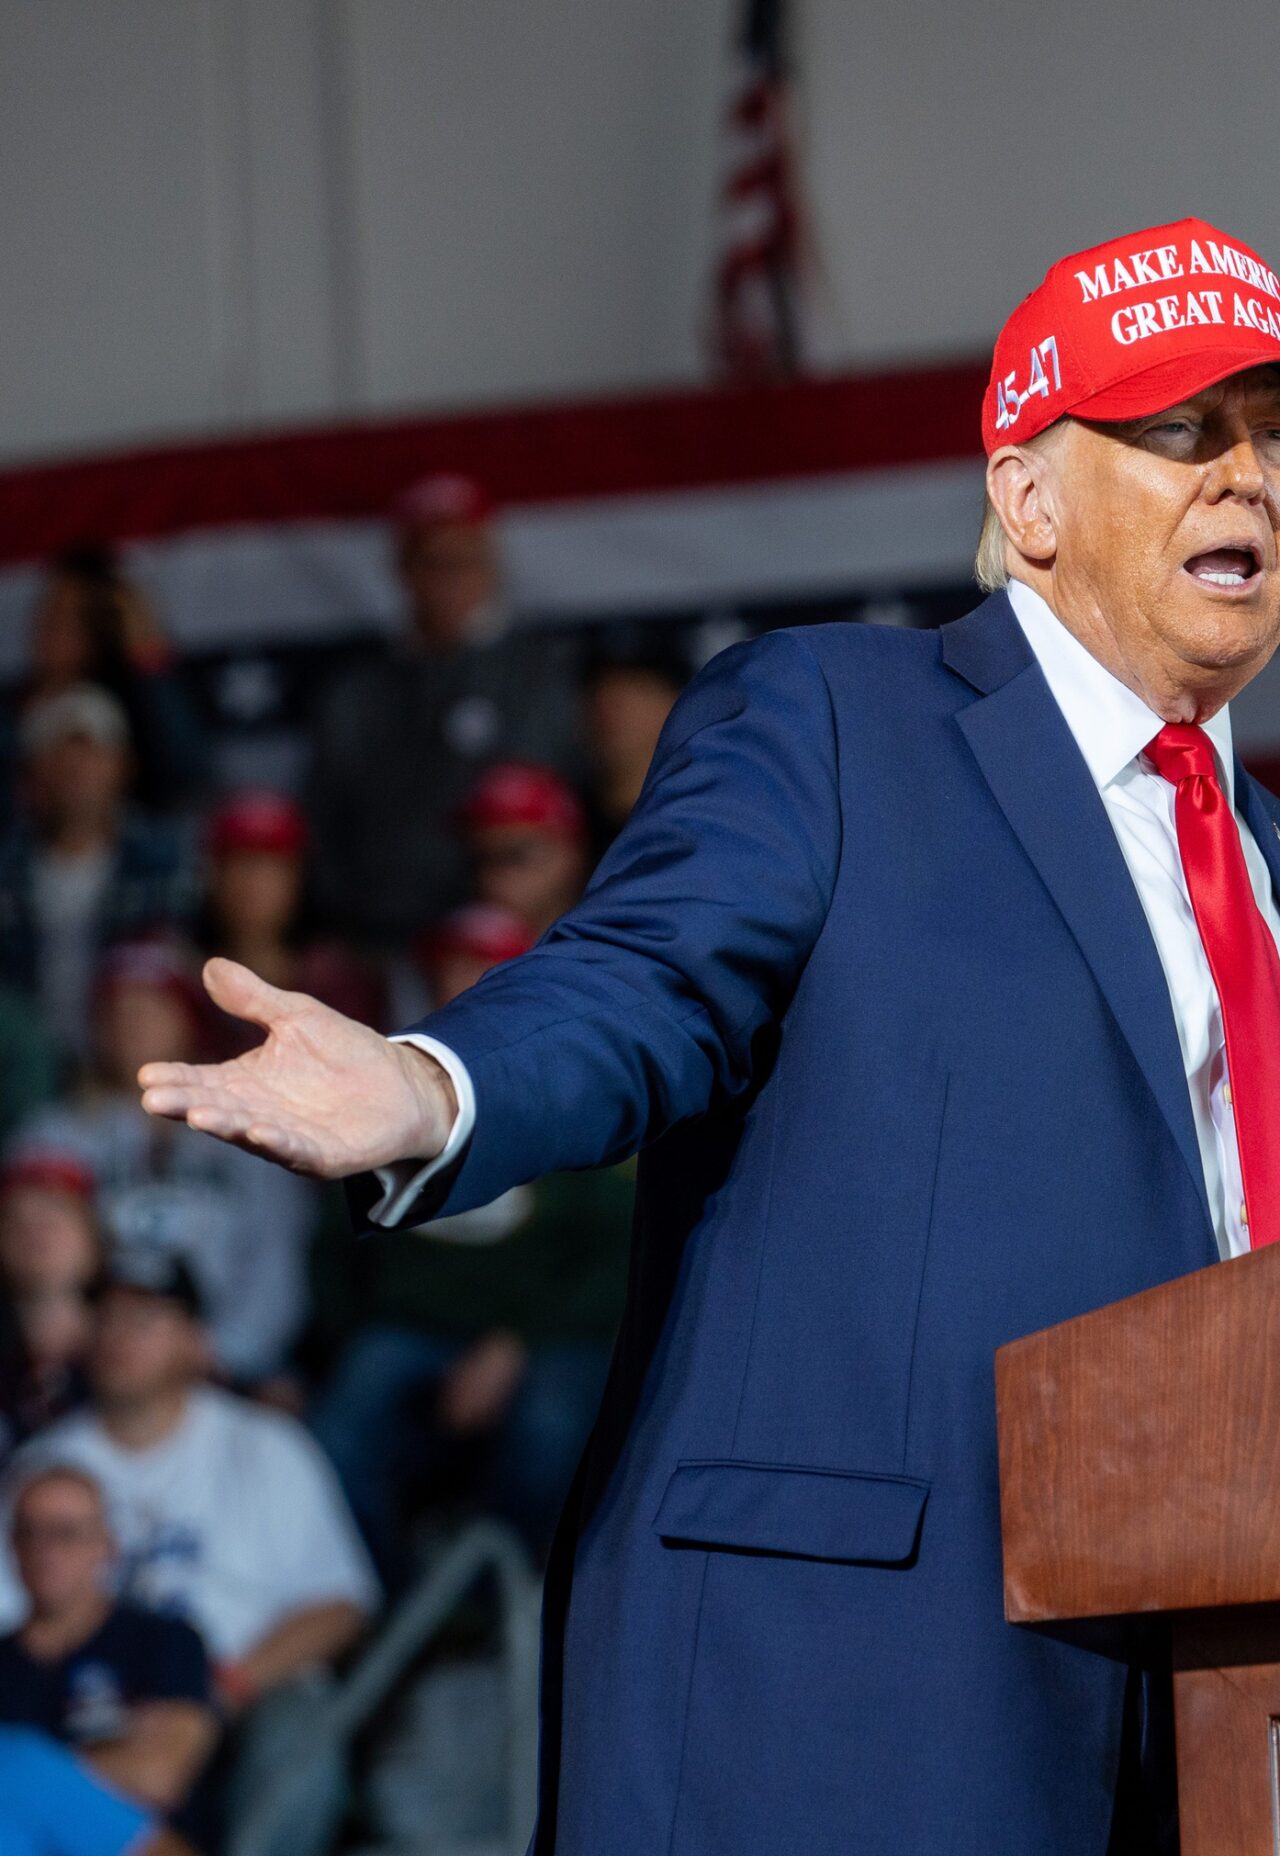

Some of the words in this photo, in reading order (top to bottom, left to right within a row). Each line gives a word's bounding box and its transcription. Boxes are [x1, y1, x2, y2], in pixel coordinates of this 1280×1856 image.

[1073, 244, 1185, 304] MAKE
[1111, 290, 1226, 346] GREAT
[996, 335, 1062, 430] 45-47
